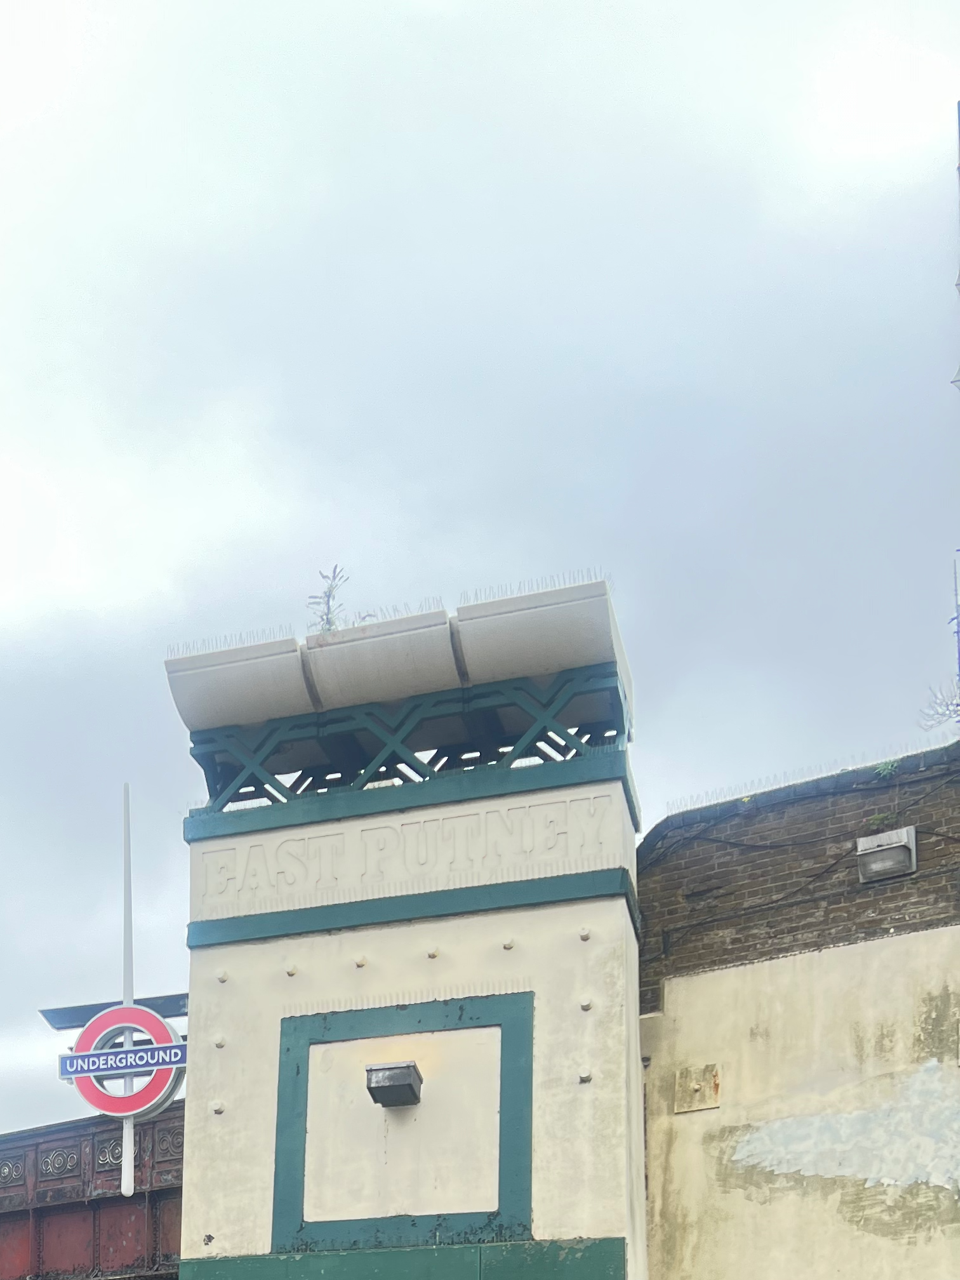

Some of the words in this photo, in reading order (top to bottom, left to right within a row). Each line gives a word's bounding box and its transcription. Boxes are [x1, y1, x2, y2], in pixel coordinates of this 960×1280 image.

[202, 833, 345, 904] EAST
[361, 795, 612, 884] PUTNEY
[66, 1049, 182, 1072] UNDERGROUND
